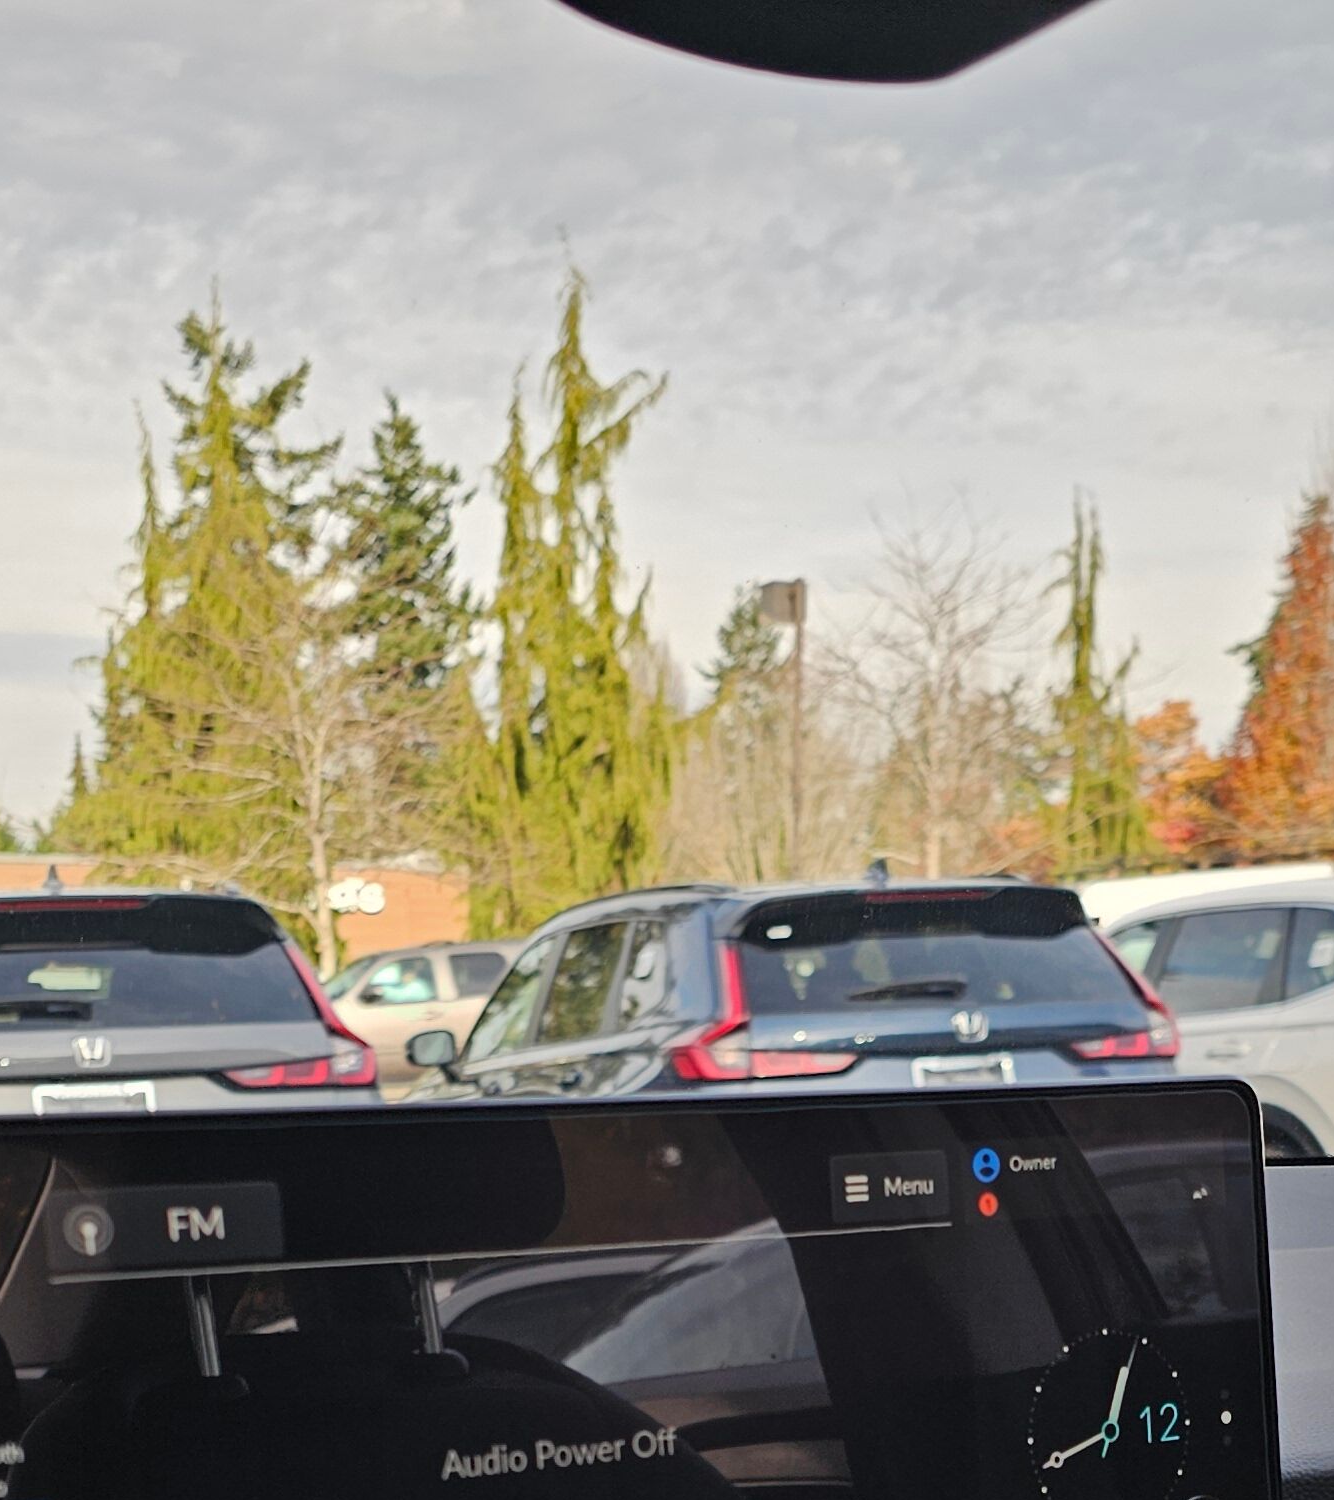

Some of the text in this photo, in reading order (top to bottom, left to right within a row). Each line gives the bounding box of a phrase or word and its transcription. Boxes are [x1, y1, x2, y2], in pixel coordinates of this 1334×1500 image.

[1009, 1155, 1057, 1172] Owner
[883, 1175, 935, 1198] Menu
[166, 1205, 225, 1243] FM
[1139, 1403, 1181, 1443] 12
[440, 1425, 678, 1482] Audio Power Off
